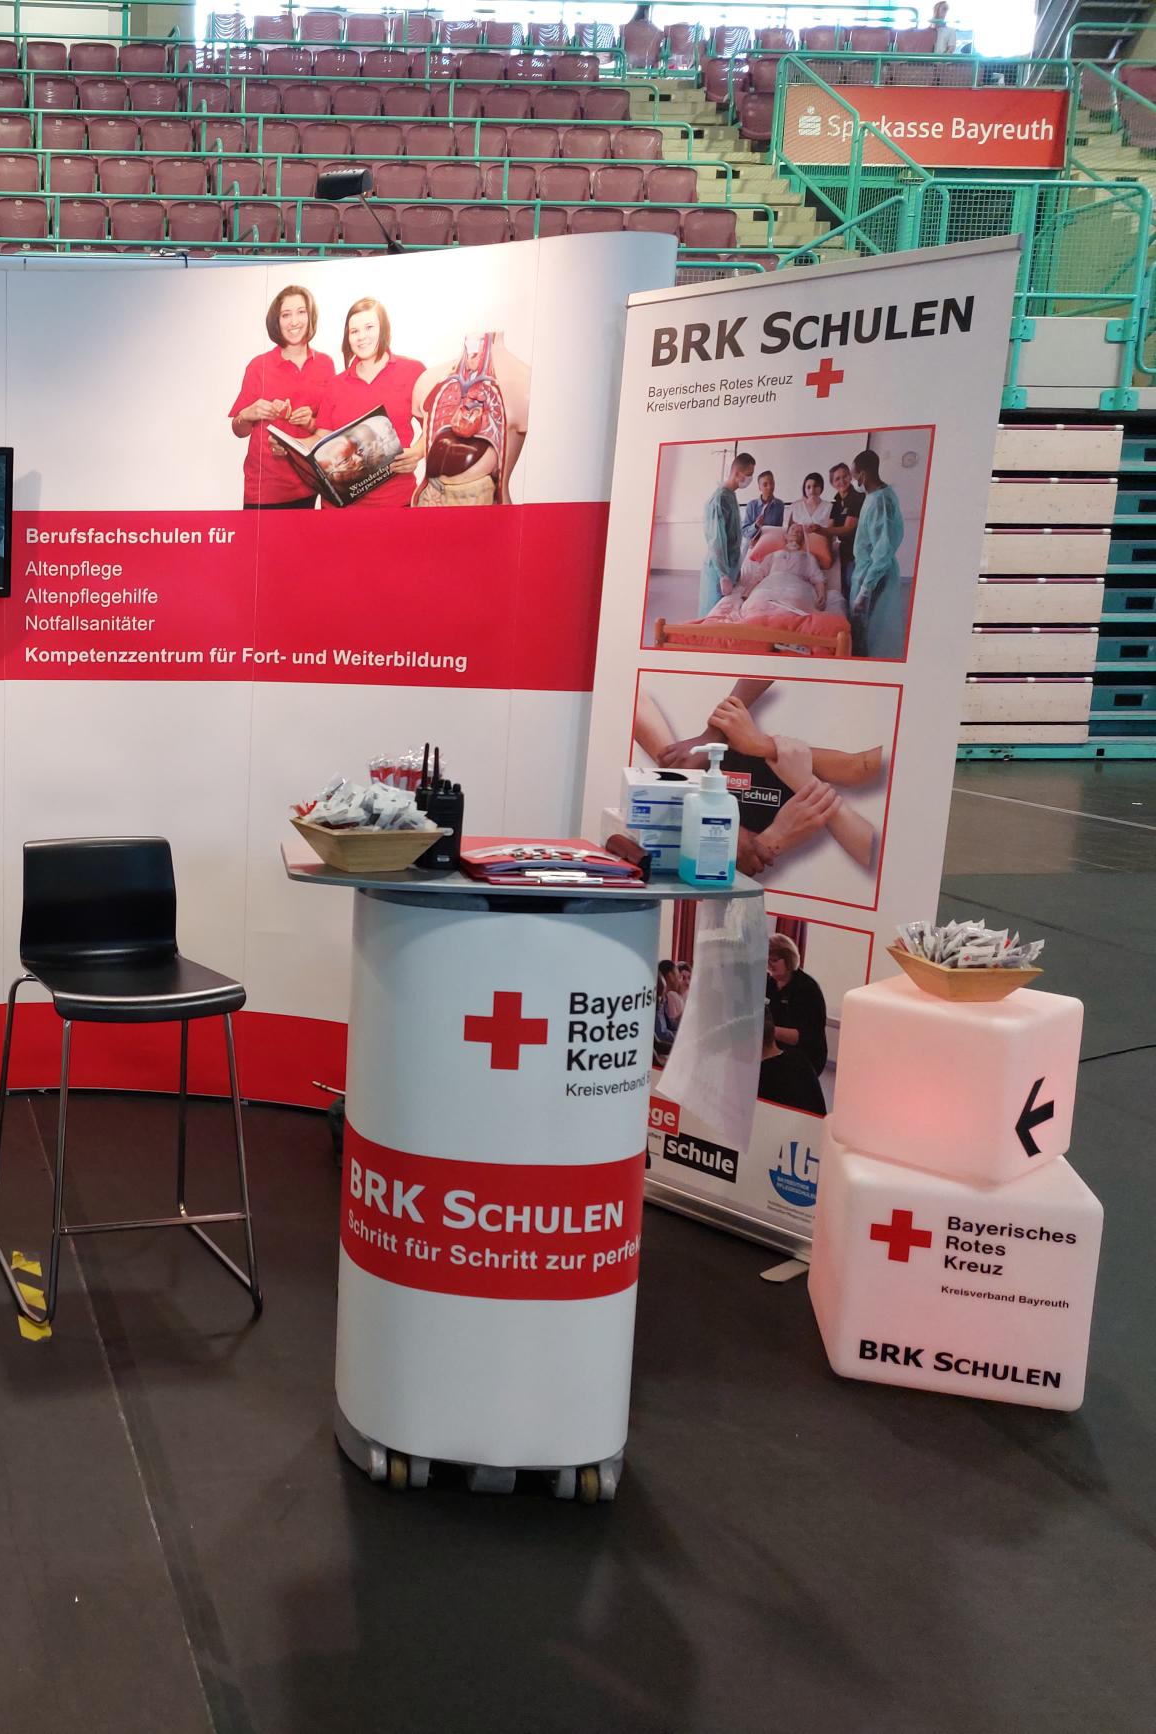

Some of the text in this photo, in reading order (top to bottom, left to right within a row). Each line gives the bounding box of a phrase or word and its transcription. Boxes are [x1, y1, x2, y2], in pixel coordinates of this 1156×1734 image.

[951, 117, 1053, 145] Bayreuth
[651, 296, 975, 368] BRK SCHULEN
[648, 372, 793, 399] Bayerisches Rotes Kreuz
[647, 391, 777, 413] Kreisverband Bayreuth
[26, 528, 236, 544] Berufsfachschulen für
[25, 561, 123, 579] Altenpflege
[25, 588, 158, 606] Altenpflegehilfe
[25, 615, 155, 632] Notfallsanitäter
[25, 647, 468, 673] Kompetenzzentrum für Fort- und Weiterbildung
[744, 790, 778, 802] schule
[568, 1020, 639, 1043] Rotes
[566, 1049, 638, 1071] Kreuz
[566, 1074, 646, 1097] Kreisverband
[666, 1140, 735, 1174] schule
[350, 1157, 624, 1234] BRK SCHULEN
[348, 1208, 397, 1253] Schritt
[404, 1236, 441, 1262] für
[449, 1244, 538, 1270] Schritt
[545, 1252, 586, 1271] zur
[947, 1216, 1077, 1244] Bayerisches
[945, 1236, 1006, 1256] Rotes
[944, 1255, 1003, 1276] Kreuz
[941, 1285, 1070, 1309] Kreisverband Bayreuth
[859, 1339, 1061, 1389] BRK SCHULEN
